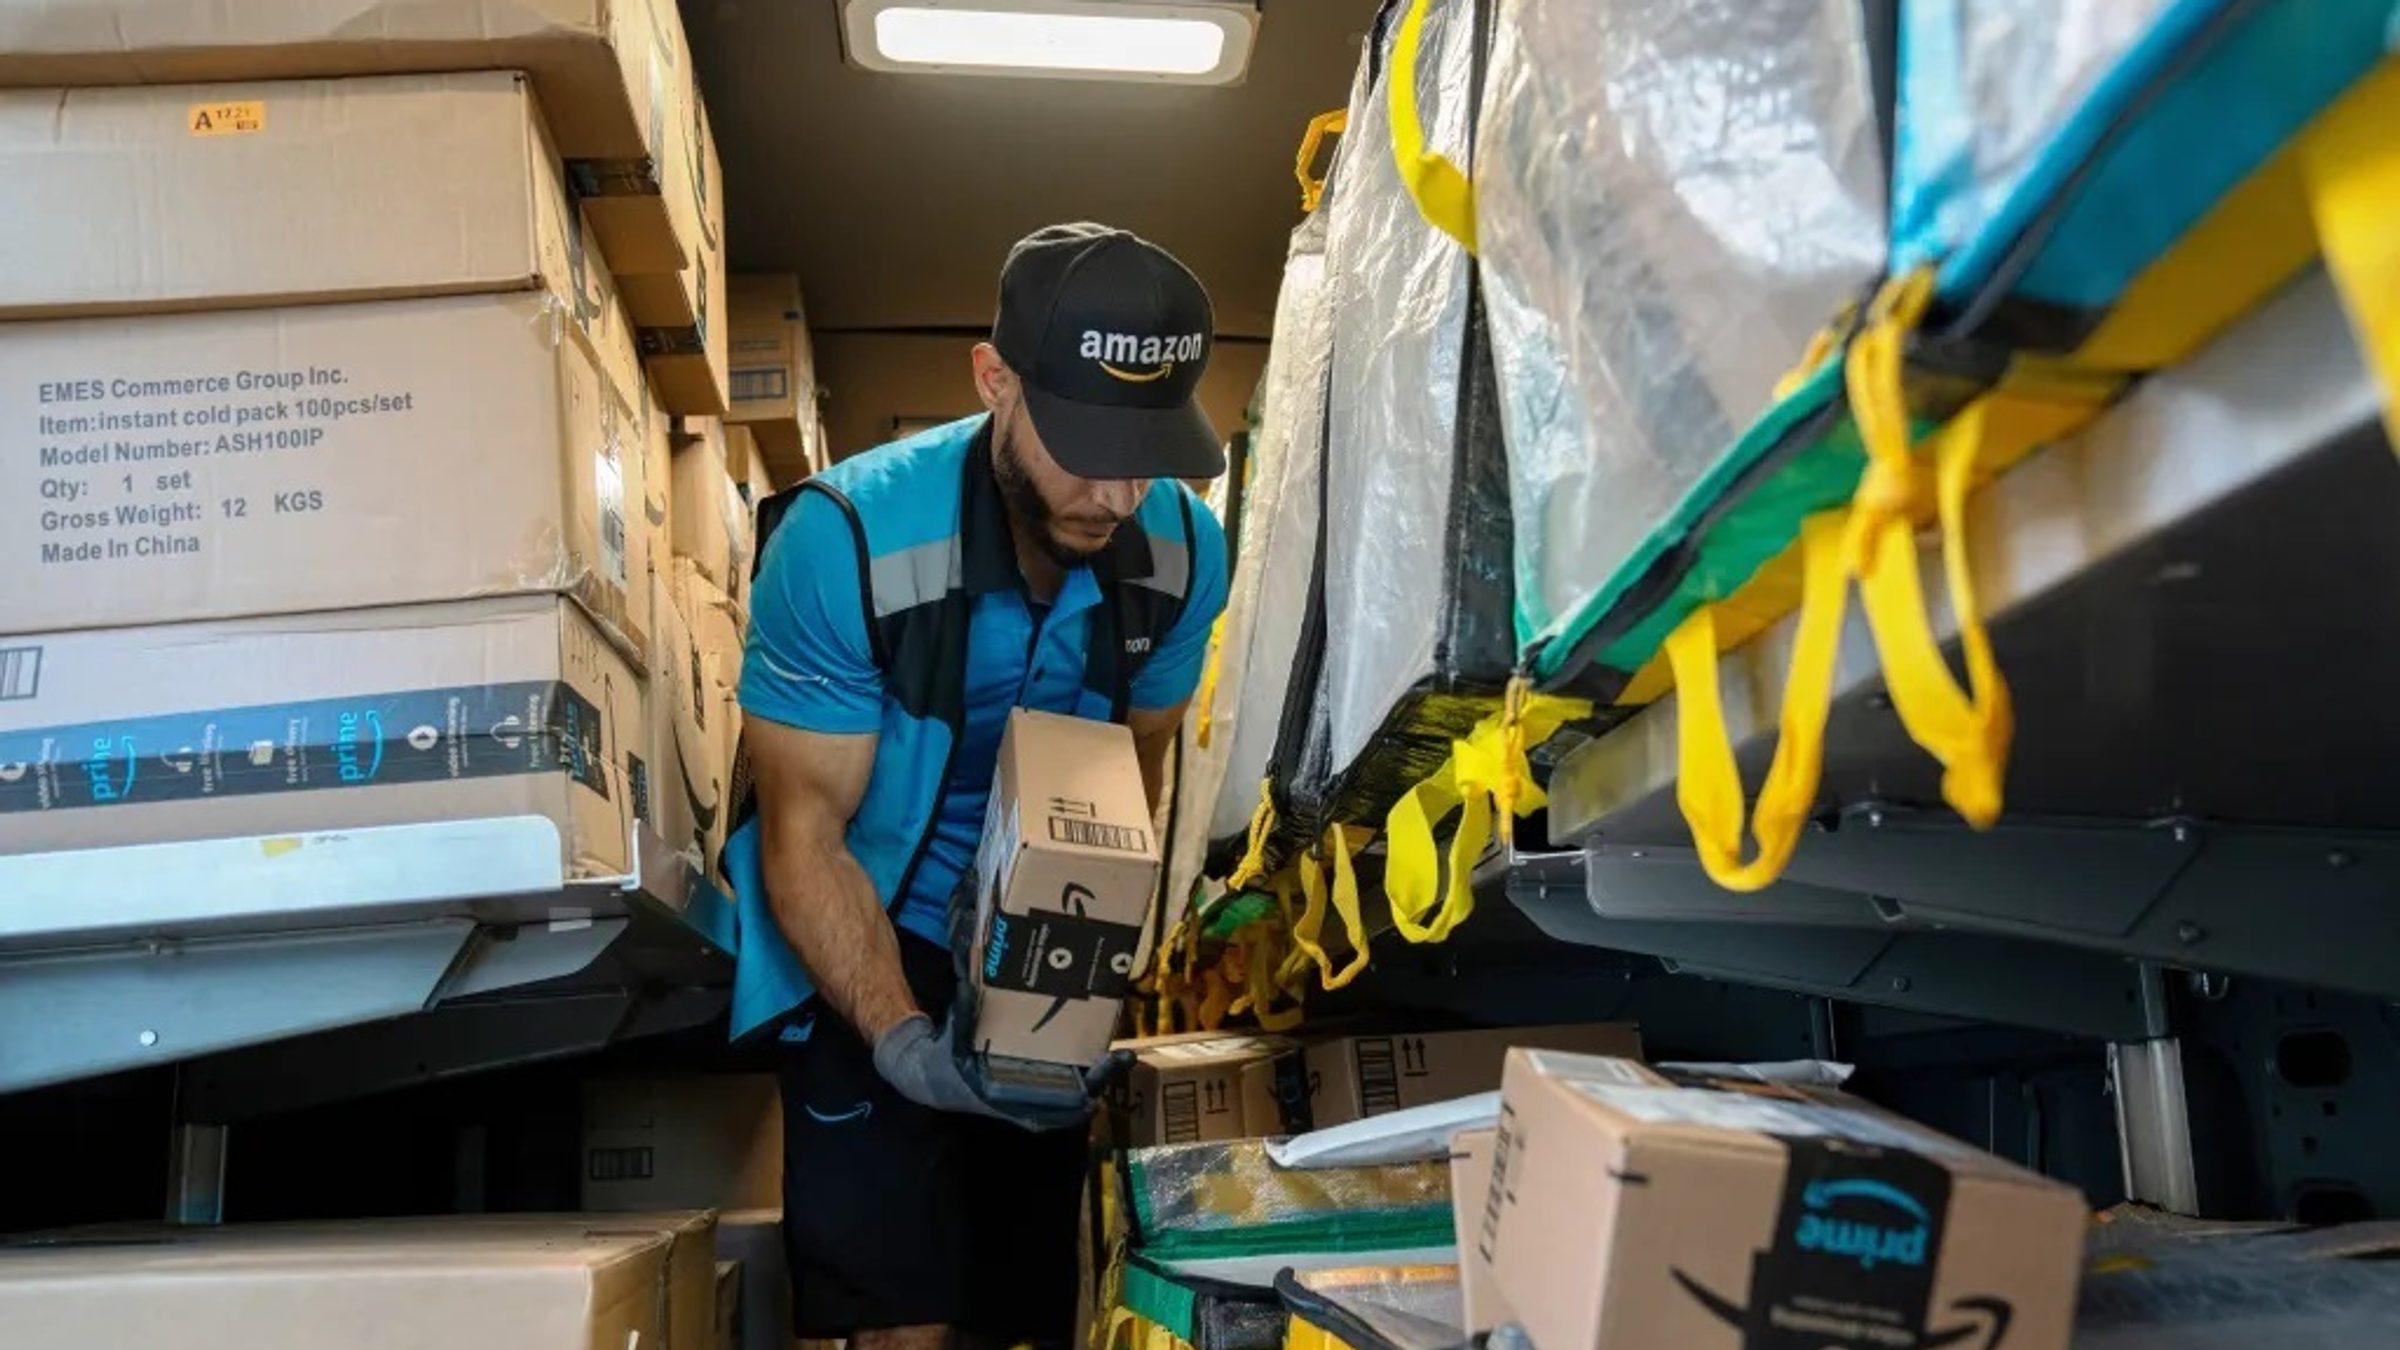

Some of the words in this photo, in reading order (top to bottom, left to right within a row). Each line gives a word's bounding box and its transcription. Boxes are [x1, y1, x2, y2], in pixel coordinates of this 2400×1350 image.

[195, 111, 213, 130] A
[1080, 329, 1203, 364] amazon
[39, 379, 105, 403] EMES
[111, 375, 230, 399] Commerce
[236, 370, 304, 391] Group
[309, 366, 348, 385] Inc.
[183, 404, 231, 426] cold
[237, 402, 288, 426] pack
[295, 392, 413, 419] 100pcs/set
[40, 443, 108, 467] Model
[115, 439, 210, 462] Number:
[215, 428, 323, 453] ASH100IP
[40, 479, 88, 501] Qty:
[122, 473, 133, 493] 1
[157, 470, 191, 491] set
[41, 510, 110, 531] Gross
[115, 502, 201, 527] Weight:
[221, 497, 247, 518] 12
[274, 490, 323, 513] KGS
[42, 541, 102, 564] Made
[108, 538, 128, 559] In
[135, 534, 200, 556] China
[330, 711, 365, 780] prime
[984, 915, 1009, 978] prime
[1795, 1215, 1928, 1271] prime
